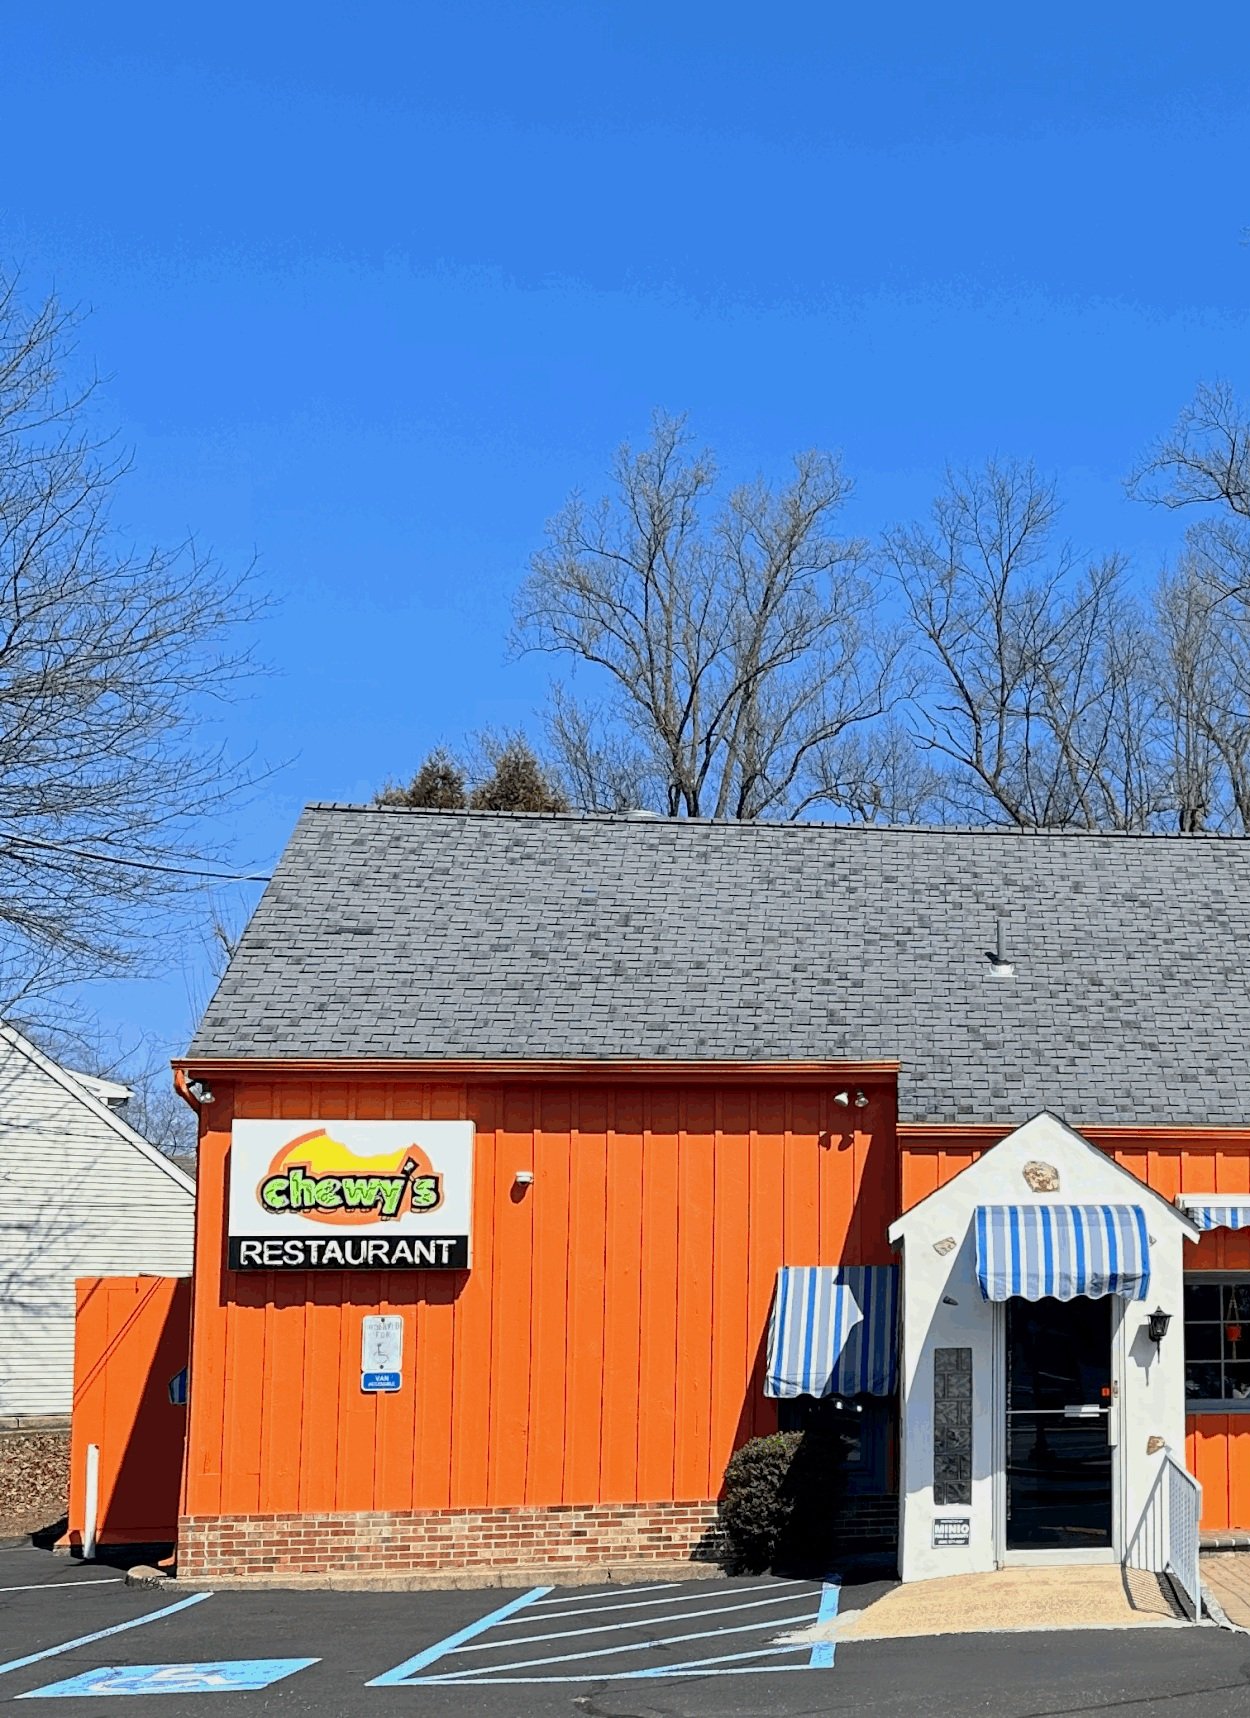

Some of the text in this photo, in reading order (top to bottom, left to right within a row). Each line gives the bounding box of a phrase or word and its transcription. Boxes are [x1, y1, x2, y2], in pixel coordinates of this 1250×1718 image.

[261, 1157, 442, 1220] chewy's
[240, 1240, 457, 1266] RESTAURANT
[934, 1523, 970, 1534] MINIO
